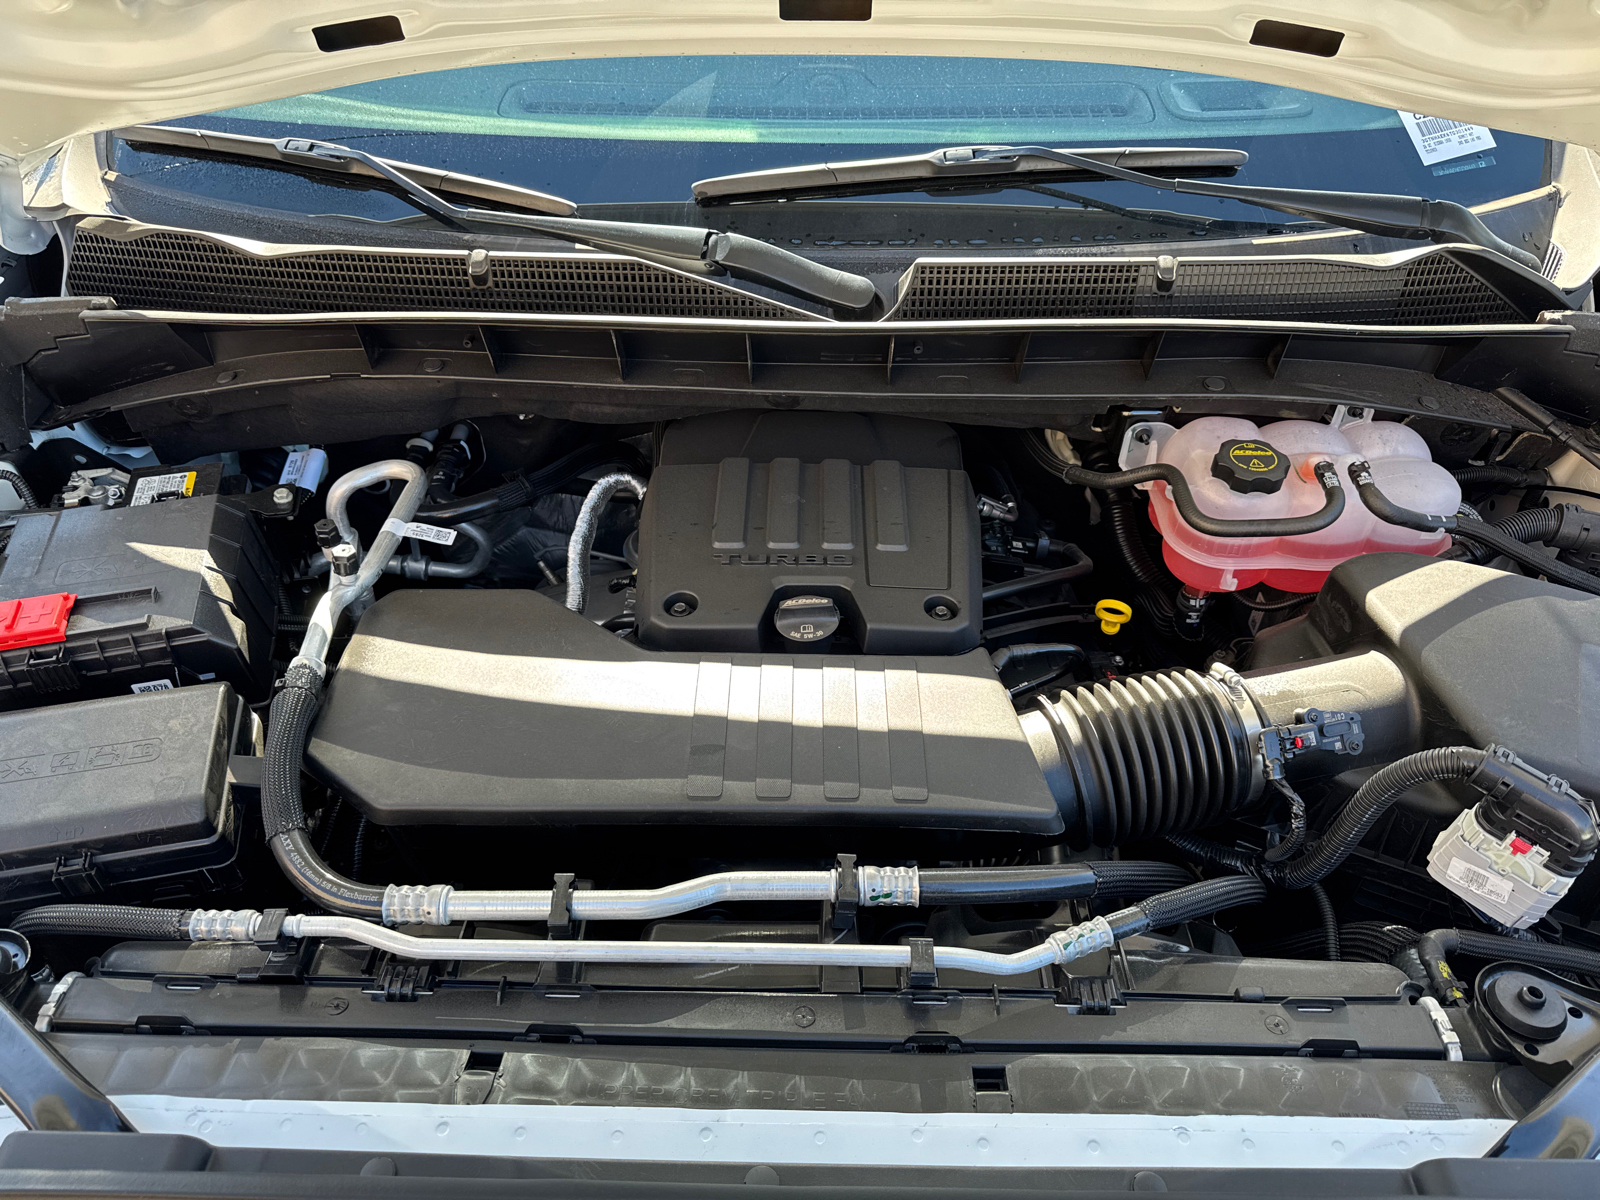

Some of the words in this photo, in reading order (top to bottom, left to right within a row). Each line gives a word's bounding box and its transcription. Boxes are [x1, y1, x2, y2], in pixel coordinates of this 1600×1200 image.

[712, 553, 853, 567] TURBO
[781, 598, 828, 608] ACDelco
[790, 631, 801, 639] SAE
[803, 630, 824, 639] 5W-30
[290, 851, 305, 869] 4882
[301, 866, 323, 885] (16mm)
[320, 881, 332, 891] 5/8
[331, 885, 338, 893] in
[338, 887, 380, 902] Flexbarrier
[585, 1082, 665, 1101] UPPER
[746, 1089, 827, 1108] TRIPLE
